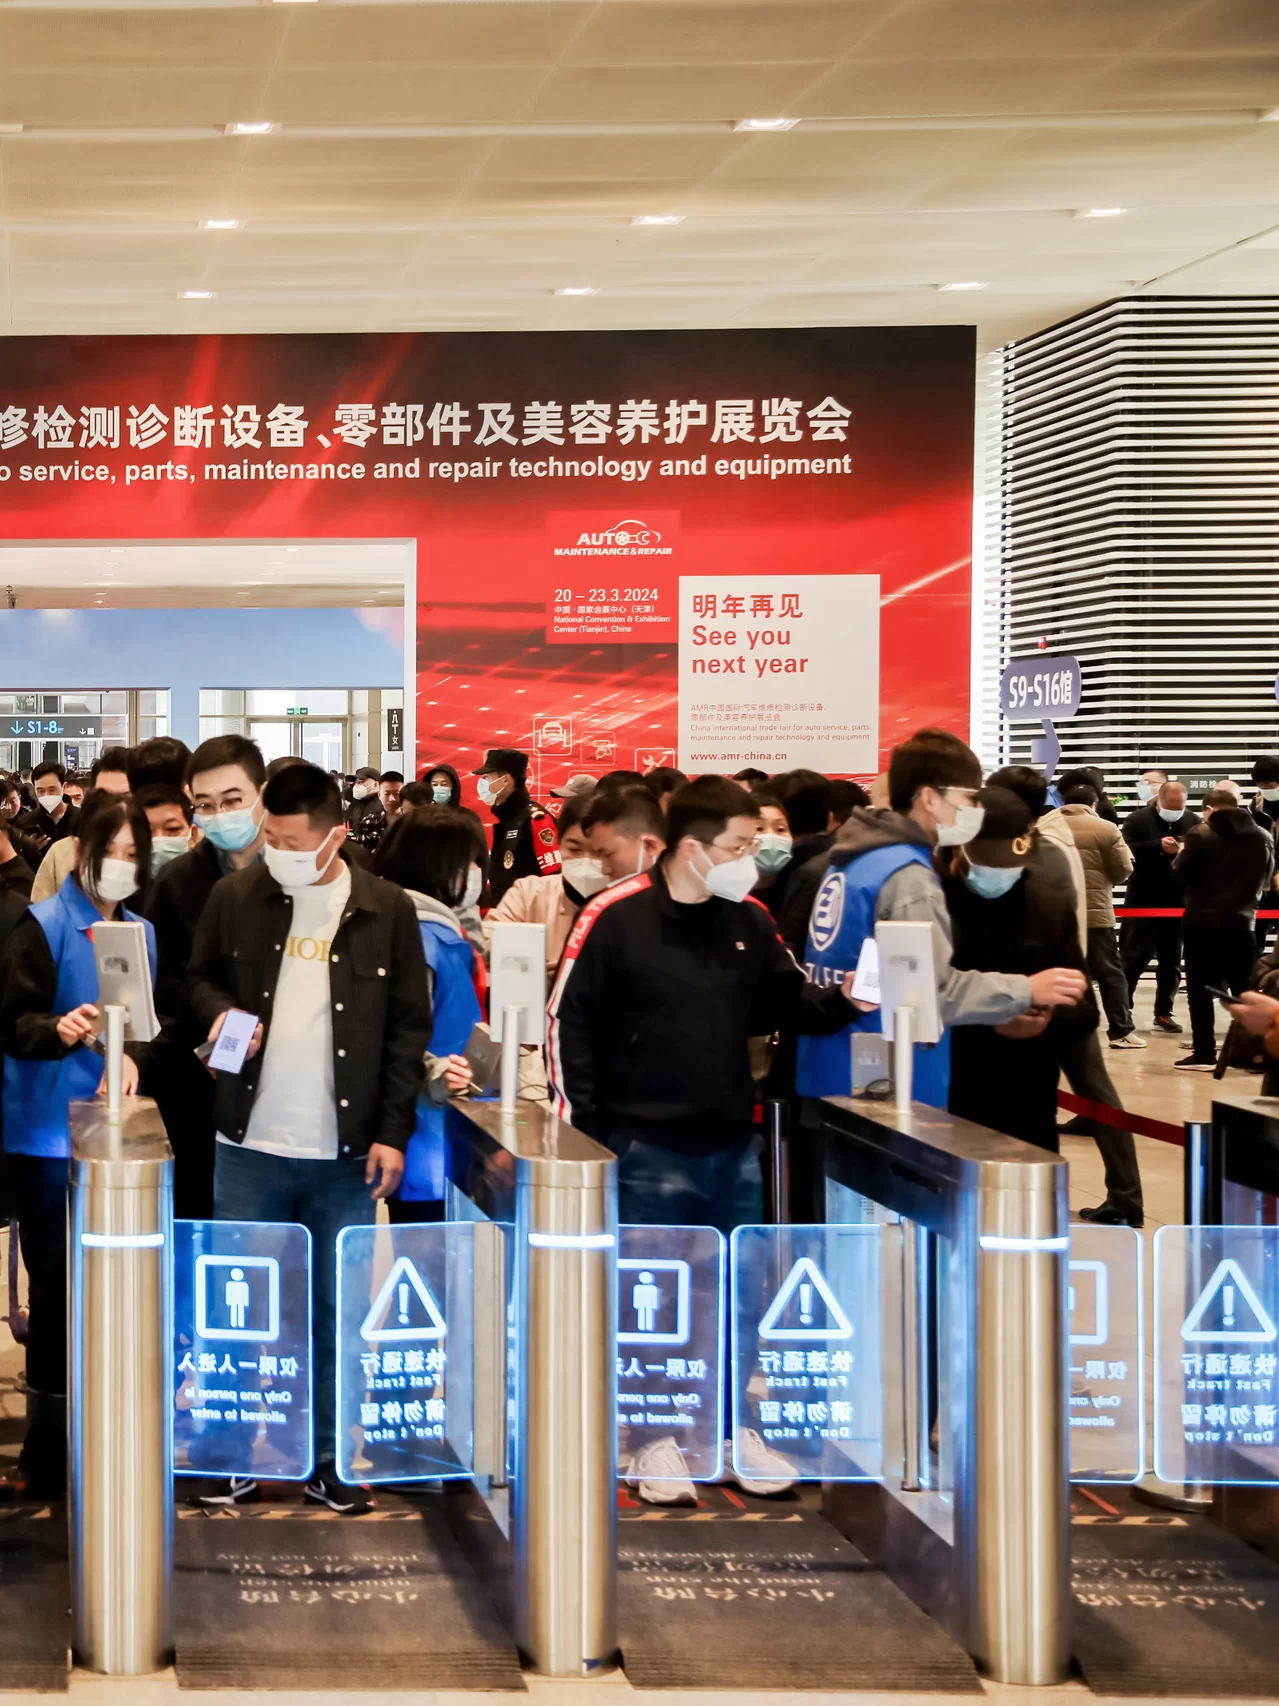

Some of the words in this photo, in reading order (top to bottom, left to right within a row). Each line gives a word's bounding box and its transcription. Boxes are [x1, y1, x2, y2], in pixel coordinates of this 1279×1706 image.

[19, 460, 116, 485] service,
[125, 460, 195, 486] parts,
[204, 458, 366, 480] maintenance
[373, 458, 420, 479] and
[429, 457, 503, 483] repair
[508, 456, 652, 482] technology
[659, 454, 707, 476] and
[714, 454, 852, 480] equipment
[554, 588, 572, 602] 20
[588, 588, 659, 602] 23.3.2024
[692, 593, 803, 619] 明年再见
[554, 625, 577, 633] Center
[611, 625, 632, 633] China
[692, 625, 737, 646] See
[746, 630, 791, 650] you
[692, 656, 745, 674] next
[754, 658, 809, 678] year
[1008, 669, 1073, 709] S9-S16馆
[690, 724, 711, 732] China
[712, 724, 757, 732] international
[759, 724, 778, 732] trade
[779, 724, 792, 732] fair
[793, 724, 803, 732] for
[805, 724, 821, 732] auto
[690, 734, 736, 742] maintenance
[753, 734, 774, 742] repair
[775, 734, 815, 742] technology
[831, 734, 870, 742] equipment
[690, 751, 788, 761] www.amr-china.cn
[568, 915, 593, 949] FILA
